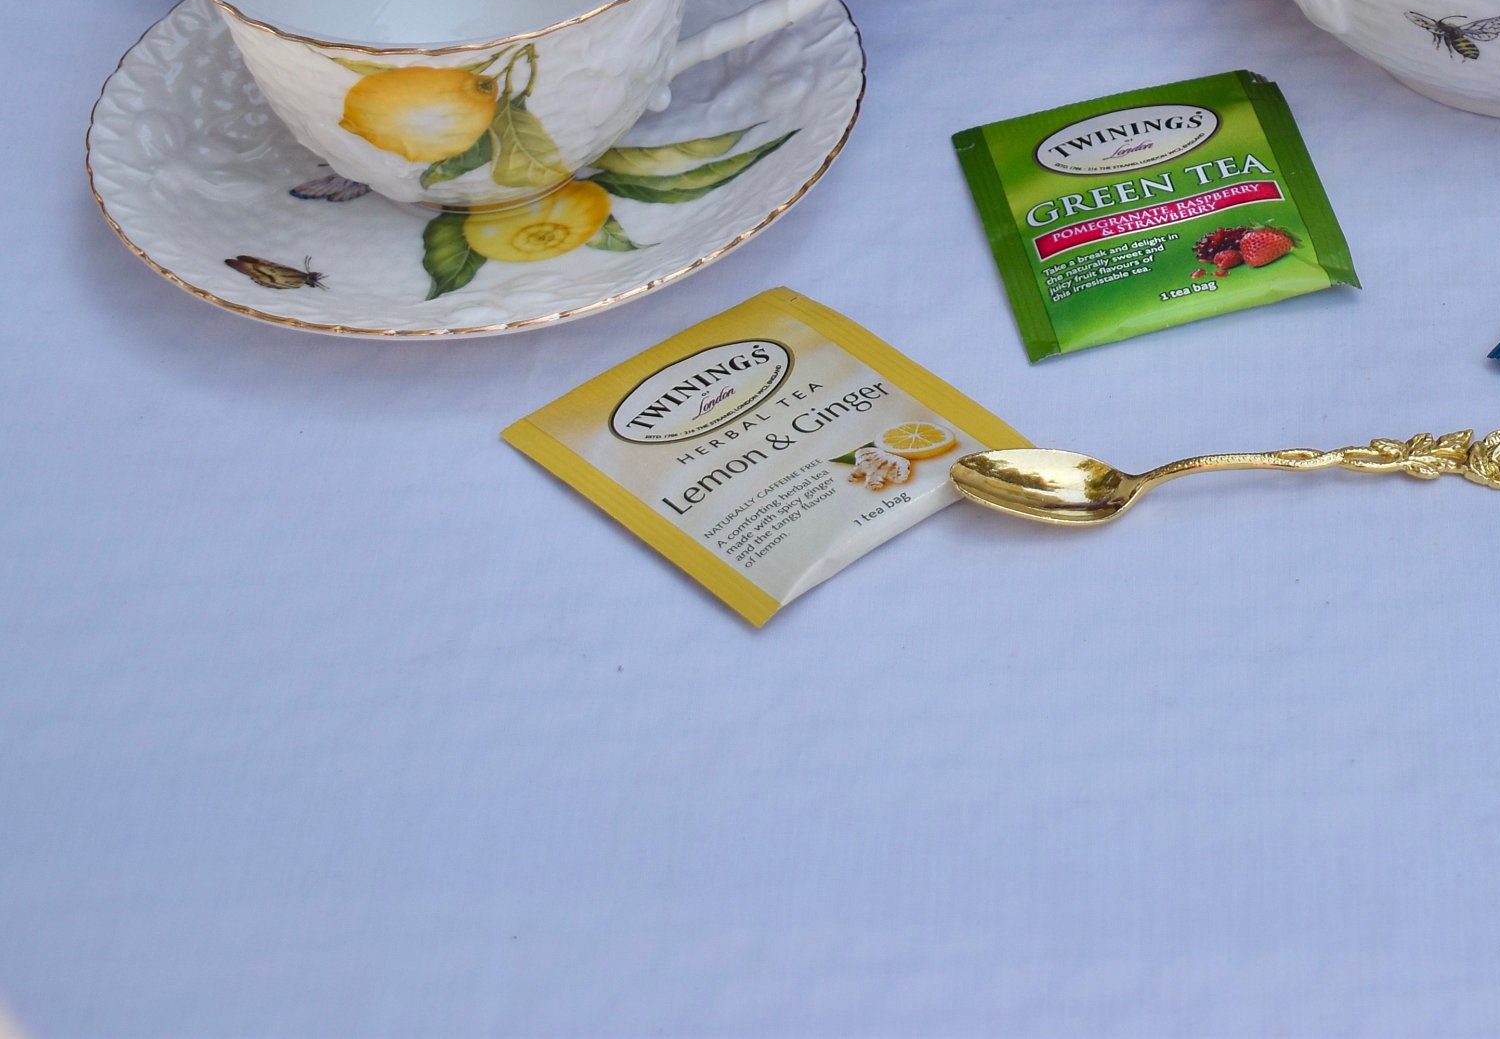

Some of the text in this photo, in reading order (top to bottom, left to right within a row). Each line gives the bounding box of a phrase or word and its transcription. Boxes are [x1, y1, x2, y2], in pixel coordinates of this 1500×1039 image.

[1026, 154, 1273, 227] GREEN TEA
[1052, 184, 1260, 241] POMEGRANATE, RASPBERRY
[1102, 202, 1216, 236] & STRAWBERRY
[1043, 263, 1066, 277] Take
[1077, 250, 1107, 263] break
[1110, 244, 1128, 254] and
[1132, 237, 1166, 250] delight
[1046, 245, 1164, 286] the naturally sweet and
[1050, 256, 1154, 295] juicy fruit flavours of
[1053, 290, 1070, 302] this
[1132, 267, 1151, 275] tea.
[1170, 288, 1191, 299] tea
[1193, 281, 1217, 292] bag
[676, 382, 823, 464] HERBAL TEA
[692, 386, 736, 420] London
[662, 381, 889, 515] Lemon & Ginger
[704, 459, 823, 539] NATURALLY CAFFEINE FREE
[717, 470, 829, 548] A comforting herbal tea
[726, 477, 835, 555] made with spicy ginger
[854, 492, 912, 527] 1 tea bag
[736, 488, 837, 562] and the tangy flavour
[745, 532, 791, 569] of lemon.
